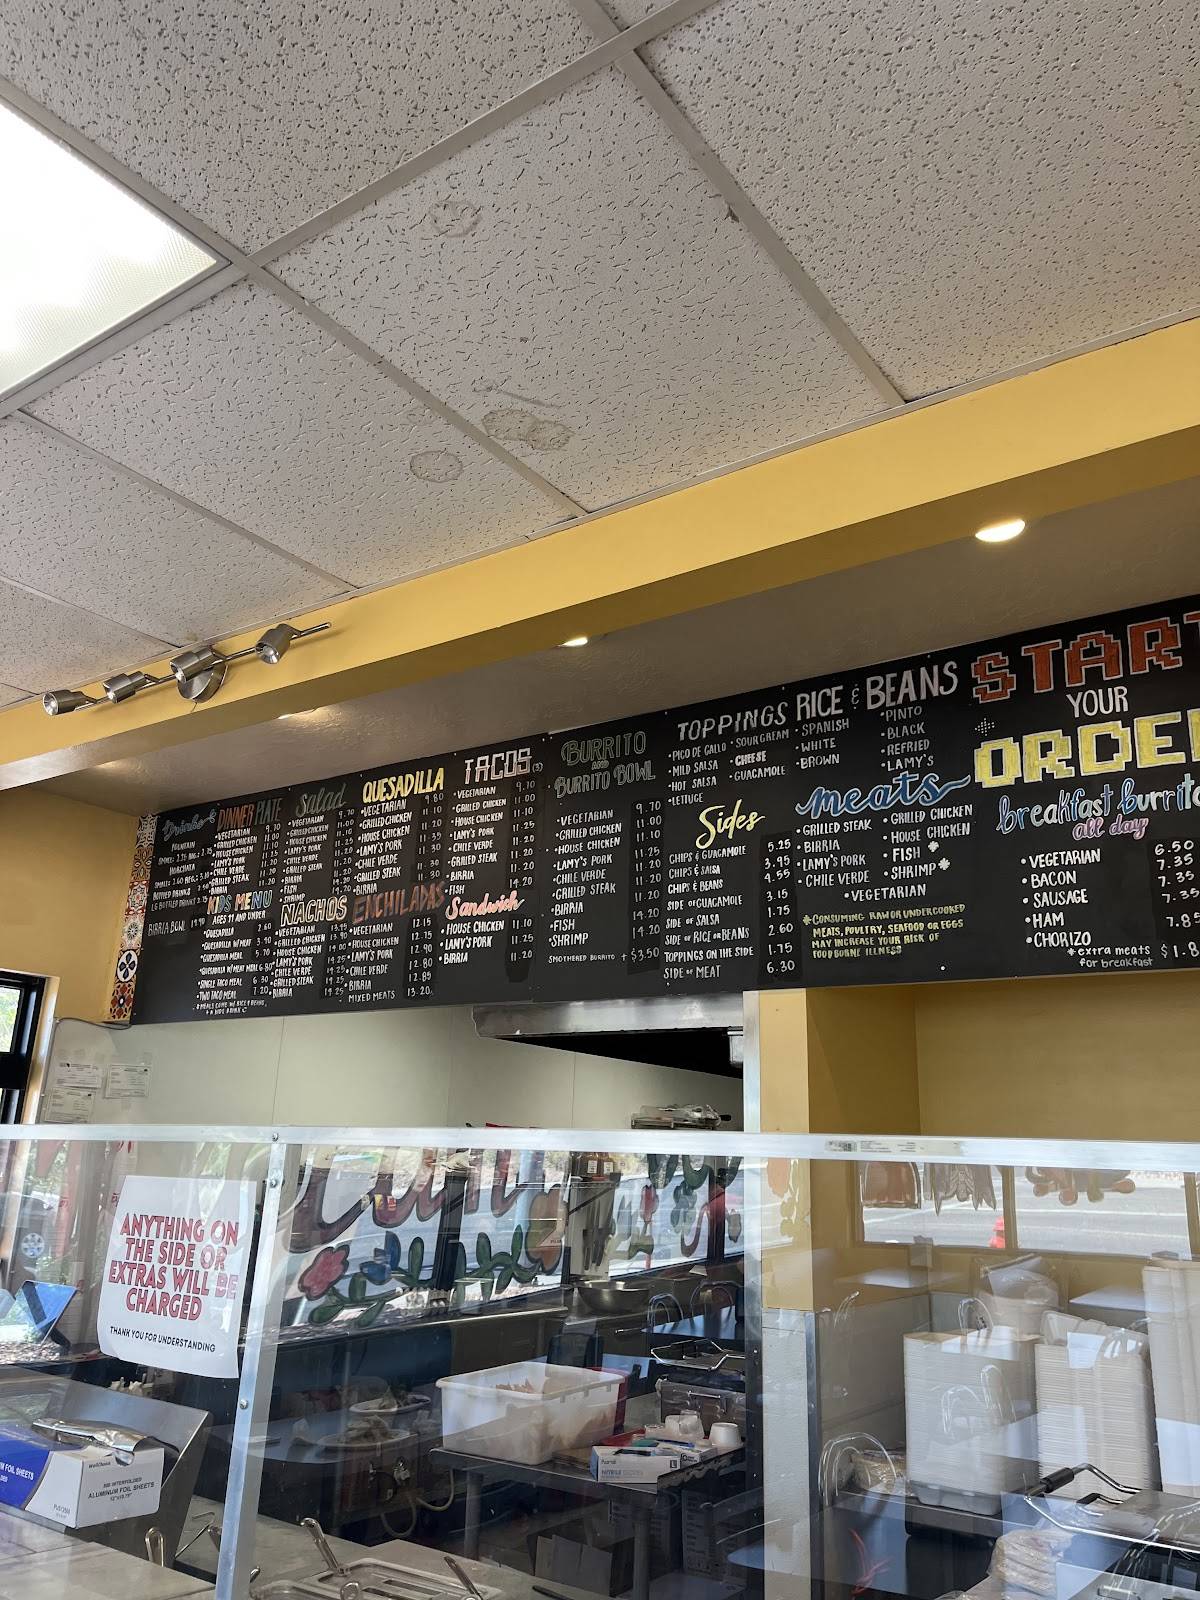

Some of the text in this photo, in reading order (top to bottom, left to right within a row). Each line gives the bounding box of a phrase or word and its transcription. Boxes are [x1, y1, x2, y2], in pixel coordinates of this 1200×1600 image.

[796, 661, 958, 721] RICE BEANS
[1066, 686, 1129, 718] YOUR
[678, 701, 788, 741] TOPPINGS
[886, 706, 923, 721] PINTO
[801, 718, 850, 736] SPANISH
[887, 722, 925, 740] BLACK
[561, 730, 647, 766] BURRITO
[736, 735, 759, 748] SOUR
[801, 738, 836, 752] WHITE
[887, 739, 930, 756] REFRIED
[974, 708, 1200, 788] ORDE
[672, 742, 726, 761] PICO GALLO
[735, 750, 766, 766] CHEESE
[464, 747, 533, 785] TACOS
[672, 760, 719, 777] MILD SALSA
[800, 754, 840, 769] BROWN
[887, 755, 934, 771] LAMY'S
[554, 760, 656, 799] BURRITO BOWL
[734, 765, 786, 781] GUACAMOLE
[362, 767, 445, 803] QUESADILLA
[457, 786, 497, 799] VEGETARIAN
[671, 776, 717, 791] HOT SALSA
[296, 782, 347, 818] Salad
[795, 771, 971, 820] meats
[217, 798, 283, 832] DINNER PLATE
[363, 799, 407, 817] VEGETARIAN
[561, 800, 661, 827] VEGETARIAN 9.70
[891, 804, 973, 824] GRILLED CHICKEN
[996, 783, 1113, 834] breakfast
[381, 825, 411, 840] CHICKEN
[560, 815, 662, 841] GRILLED CHICKEN 11.00
[696, 799, 766, 849] Sides
[802, 819, 872, 836] GRILLED STEAK
[891, 822, 970, 844] HOUSE CHICKEN
[1072, 814, 1149, 840] all day
[360, 839, 403, 856] LAMY'S PORK
[558, 829, 661, 855] HOUSE CHICKEN 11.10
[804, 839, 840, 853] BIRRIA
[669, 839, 791, 864] CHIPS GUACAMOLE 5.25
[892, 846, 921, 863] FISH
[1029, 840, 1194, 868] VEGETARIAN 6.50
[557, 853, 613, 871] LAMY'S PORK
[669, 855, 790, 879] CHIPS SALSA 3.95
[802, 853, 866, 871] LAMY'S PORK
[891, 862, 937, 880] SHRIMP
[1031, 853, 1194, 888] BACON 7.35
[556, 868, 607, 885] CHILE VERDE
[668, 868, 791, 894] CHIPS BEANS 4.55
[805, 870, 870, 887] CHILE VERDE
[448, 884, 465, 896] FISH
[555, 882, 616, 900] GRILLED STEAK
[851, 884, 926, 902] VEGETARIAN
[1033, 871, 1194, 908] SAUSAGE 7.35
[207, 890, 272, 914] KIDS MENU
[280, 895, 348, 927] NACHOS
[352, 881, 446, 924] ENCHILADAS
[445, 889, 526, 920] Sandwich
[554, 902, 584, 916] BIRRIA
[667, 895, 743, 911] SIDE GUACAMOLE
[1032, 888, 1200, 928] HAM 7.35
[553, 918, 575, 932] FISH
[665, 905, 791, 929] SIDE SALSA 1.75
[279, 925, 315, 937] VEGETARIAN
[353, 922, 393, 936] VEGETARIAN
[446, 920, 505, 935] HOUSE CHICKEN
[665, 923, 794, 946] SIDE RICE BEANS 2.60
[887, 919, 964, 934] SEAFOOD EGGS
[445, 936, 493, 951] LAMY'S PORK
[551, 932, 589, 948] SHRIMP
[812, 934, 925, 948] MAY INCREASE YOUR RISK
[1034, 932, 1091, 947] CHORIZO
[351, 944, 433, 963] LAMY'S 12.90
[443, 952, 468, 965] BIRRIA
[664, 942, 793, 963] TOPPINGS ON THE SIDE 1.75
[1115, 945, 1150, 955] meats
[664, 960, 795, 980] SIDE MEAT 6.30
[1101, 957, 1152, 968] breakfast
[348, 990, 396, 1003] MIXED MEATS
[119, 1212, 240, 1247] ANYTHING ON
[125, 1237, 228, 1271] THE SIDE OR
[108, 1260, 240, 1300] EXTRAS WILL BE
[126, 1287, 203, 1321] CHARGED
[110, 1326, 216, 1353] THANK YOU FOR UNDERSTANDING
[88, 1487, 119, 1499] ALUMINUM
[119, 1486, 132, 1495] FOIL
[133, 1481, 155, 1491] SHEETS
